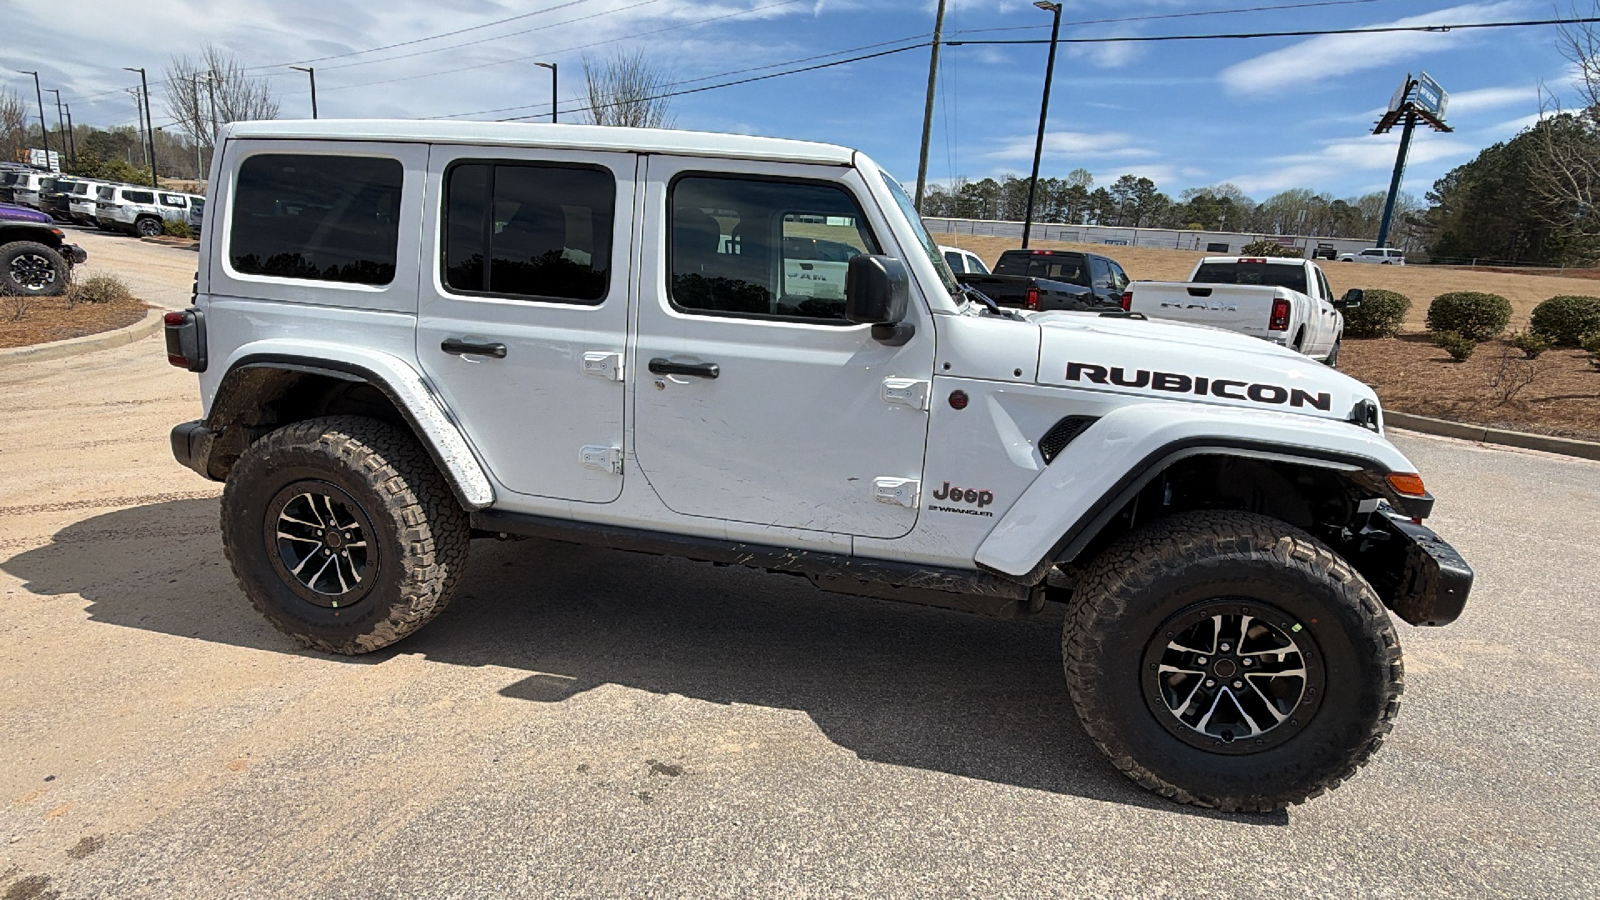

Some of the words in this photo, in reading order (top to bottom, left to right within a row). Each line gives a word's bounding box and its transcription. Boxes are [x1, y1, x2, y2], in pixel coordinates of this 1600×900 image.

[1160, 299, 1237, 312] RAM
[1065, 361, 1331, 412] RUBICON
[933, 481, 993, 508] Jeep
[938, 505, 993, 517] WRANGLER
